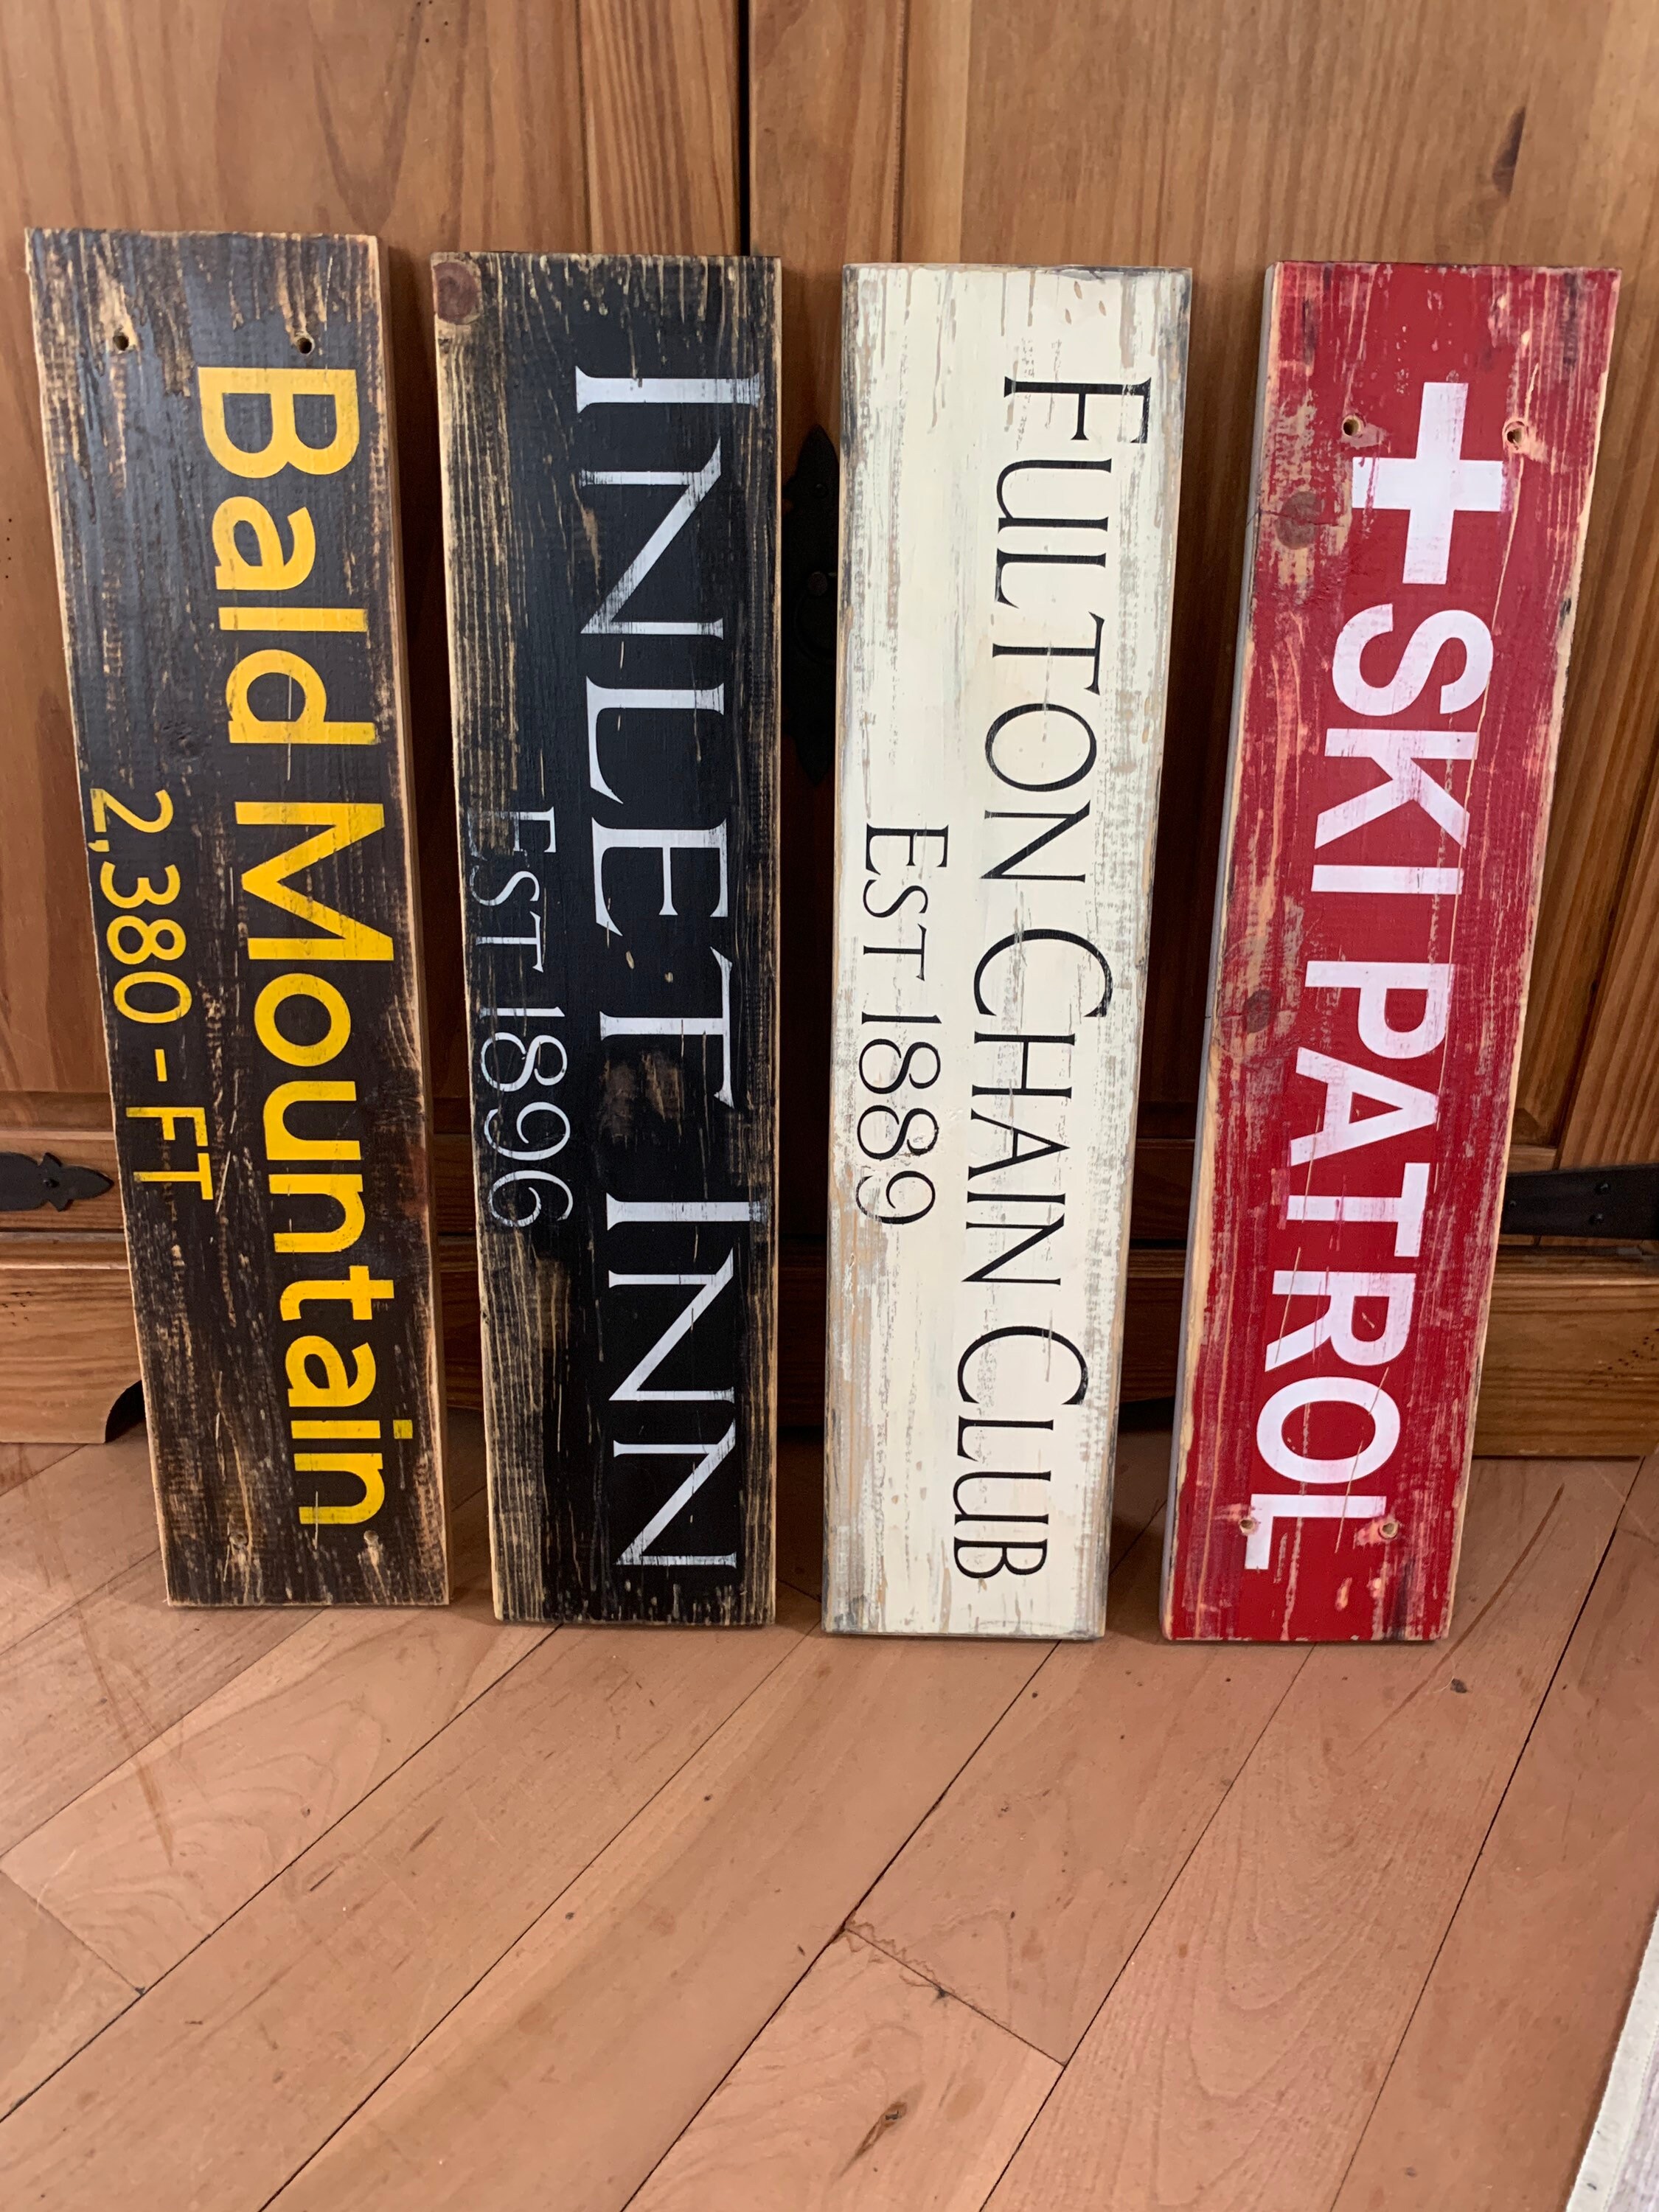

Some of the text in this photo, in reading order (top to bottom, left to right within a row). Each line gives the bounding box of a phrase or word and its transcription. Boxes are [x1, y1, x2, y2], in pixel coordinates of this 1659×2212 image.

[89, 787, 192, 1024] 2,380
[125, 1106, 214, 1200] FT
[198, 366, 414, 1526] Bald Mountain
[466, 805, 574, 1230] EST 1896
[575, 365, 769, 1568] INLET INN
[855, 823, 950, 1227] EST 1889
[952, 376, 1152, 1579] FULTON CHAIN CLUB
[1244, 602, 1495, 1571] SKI PATROL
